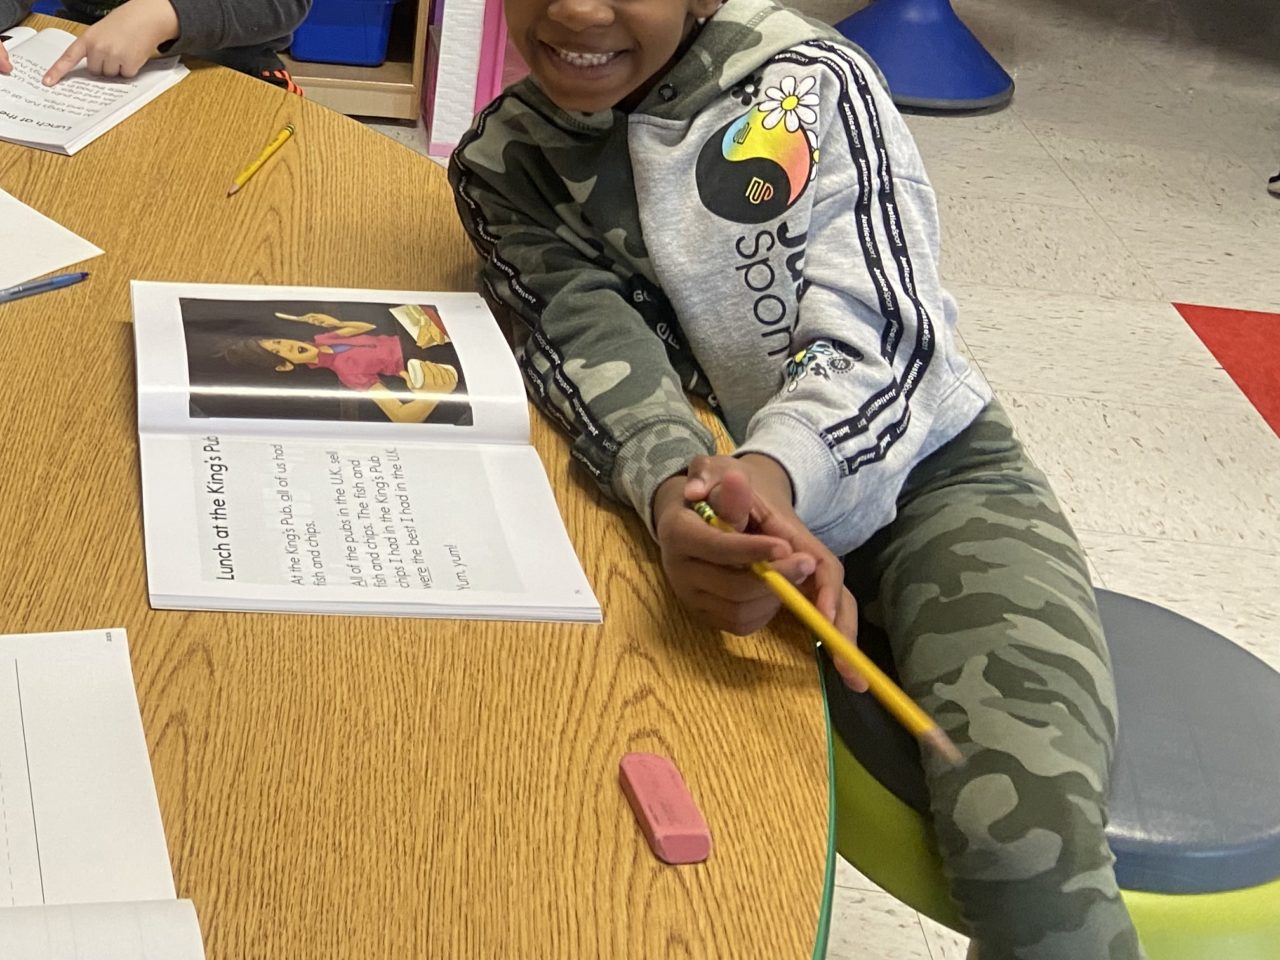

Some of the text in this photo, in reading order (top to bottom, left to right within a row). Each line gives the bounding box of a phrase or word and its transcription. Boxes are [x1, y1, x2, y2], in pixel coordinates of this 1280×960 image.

[271, 444, 285, 461] had
[326, 451, 340, 465] sell
[276, 462, 287, 474] us
[348, 459, 363, 479] and
[370, 455, 383, 474] Pub
[391, 463, 405, 480] the
[275, 476, 288, 488] of
[354, 481, 368, 499] fish
[371, 476, 390, 504] King's
[395, 482, 408, 492] in
[276, 490, 292, 502] all
[334, 488, 347, 506] the
[203, 435, 235, 581] Lunch at the King's Pub
[337, 508, 350, 518] in
[357, 502, 371, 520] The
[395, 494, 410, 517] had
[379, 506, 393, 525] the
[339, 519, 359, 544] pubs
[383, 525, 396, 535] in
[402, 525, 420, 547] best
[282, 528, 300, 555] King's
[384, 537, 399, 556] had
[306, 550, 323, 569] and
[345, 545, 359, 563] the
[366, 552, 383, 572] and
[410, 548, 425, 564] the
[288, 556, 302, 573] the
[346, 564, 362, 575] of
[291, 575, 305, 586] At
[313, 568, 327, 586] fish
[349, 576, 368, 588] All
[372, 571, 388, 588] fish
[395, 566, 412, 589] chips
[417, 566, 433, 589] were
